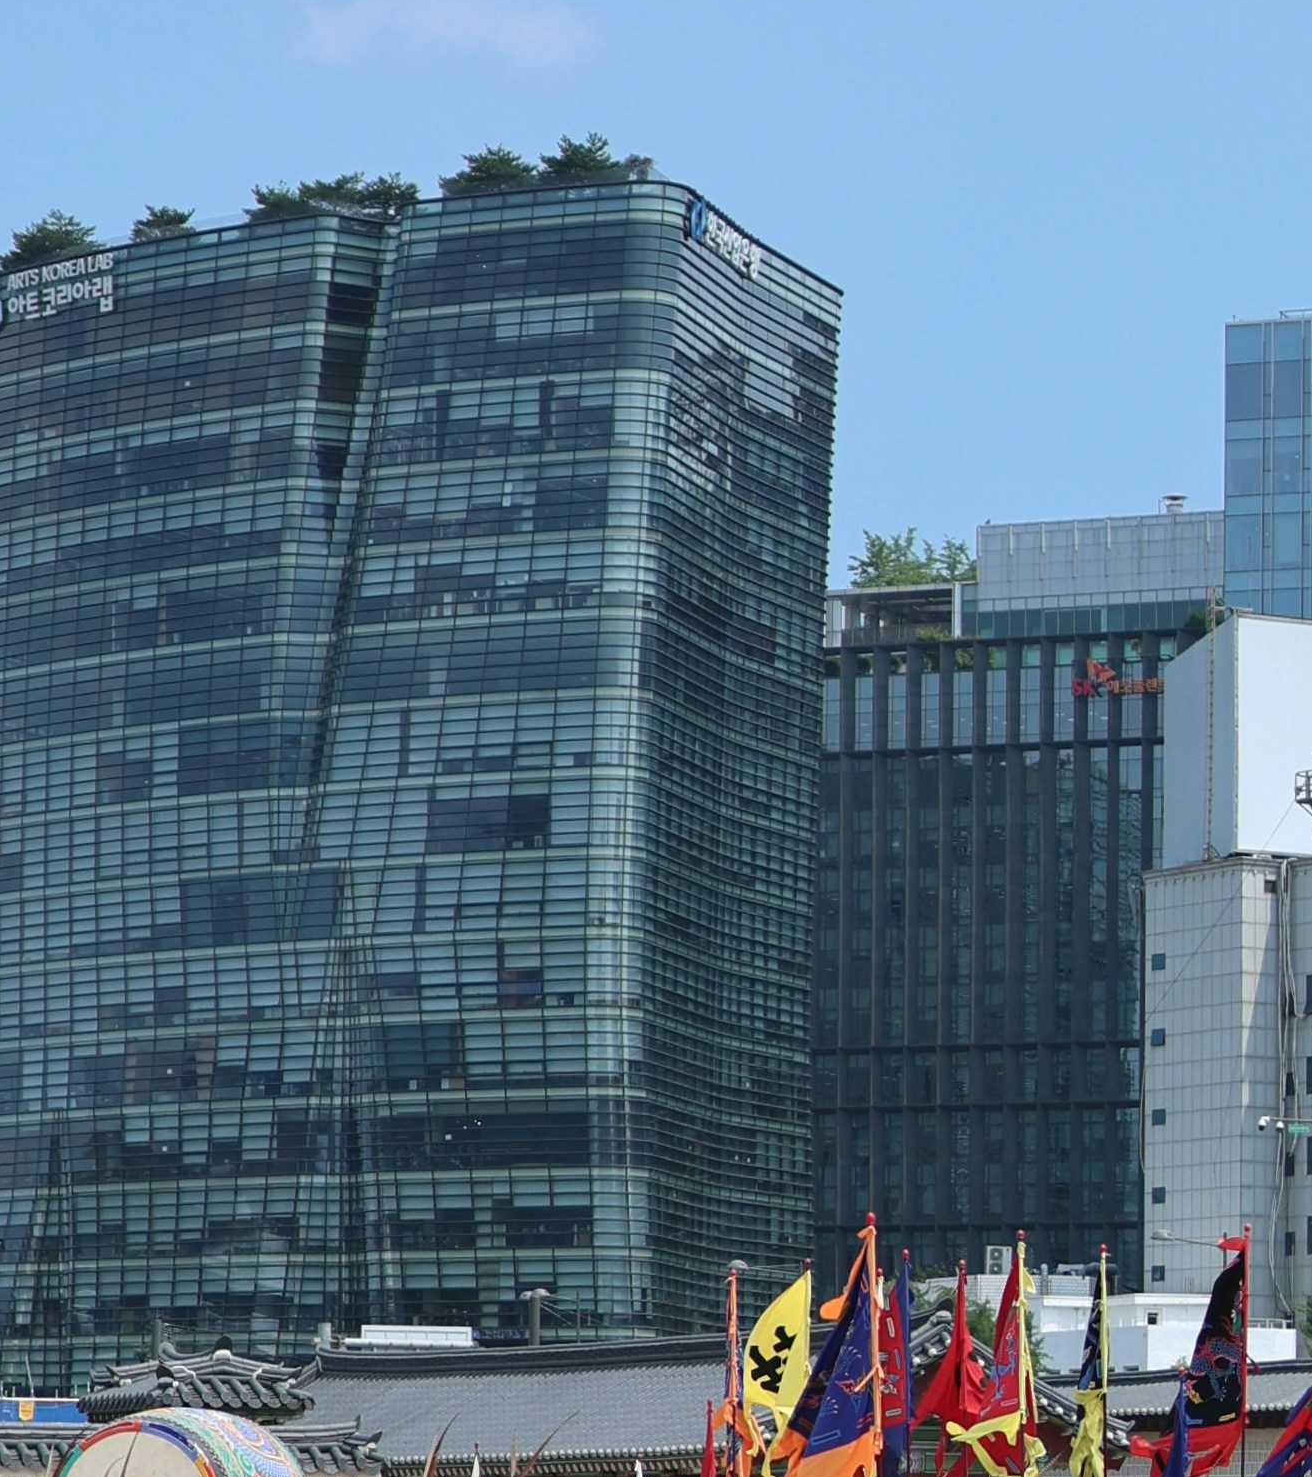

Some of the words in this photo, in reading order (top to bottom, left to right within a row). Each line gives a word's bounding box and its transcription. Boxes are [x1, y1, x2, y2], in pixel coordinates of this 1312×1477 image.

[704, 211, 762, 280] 한국산업은행
[7, 268, 40, 292] ARTS
[41, 258, 86, 283] KOREA
[87, 252, 114, 273] LAB
[1072, 679, 1097, 697] SK
